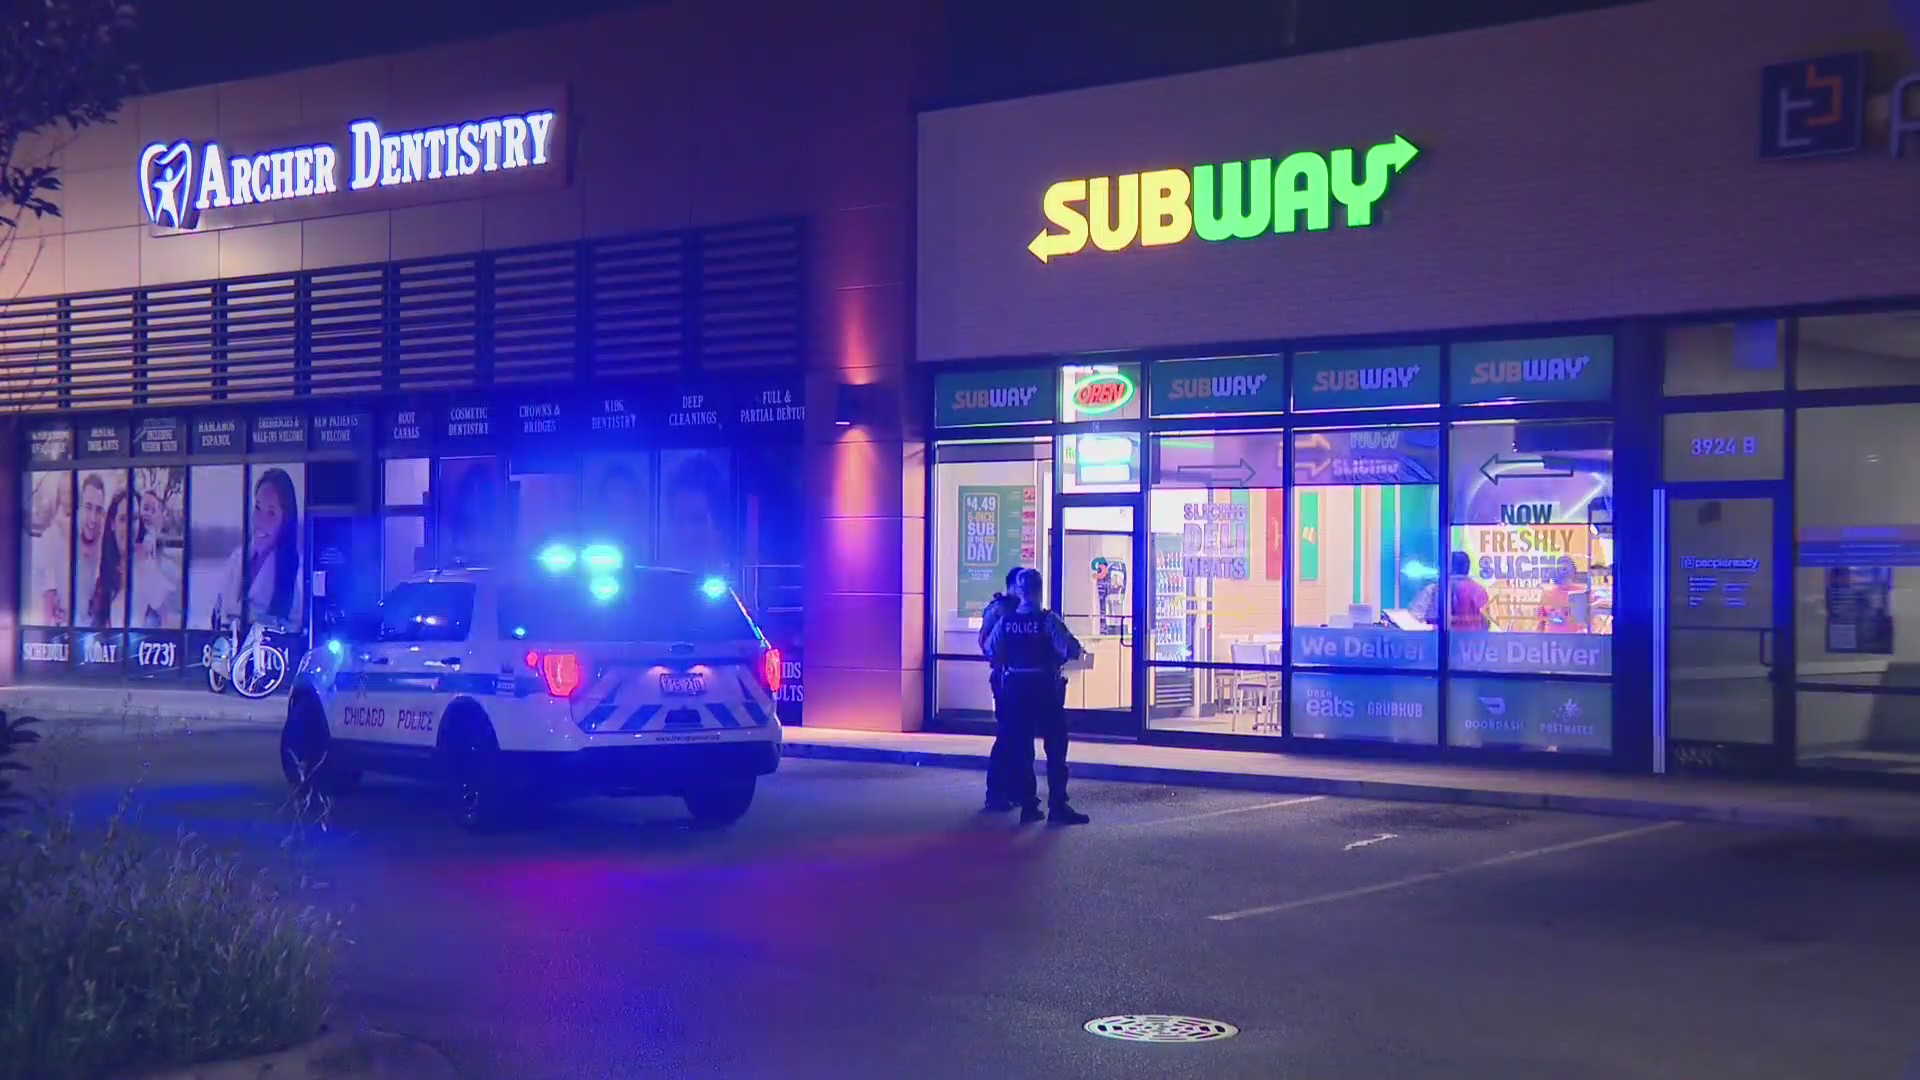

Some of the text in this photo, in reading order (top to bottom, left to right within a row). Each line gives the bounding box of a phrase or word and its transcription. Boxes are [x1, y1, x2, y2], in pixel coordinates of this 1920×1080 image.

[196, 110, 553, 210] ARCHER DENTISTRY
[1027, 133, 1419, 264] SUBWAY
[1313, 365, 1420, 393] SUBWAY
[1470, 356, 1591, 385] SUBWAY
[1077, 383, 1126, 405] OPEN
[1168, 373, 1268, 401] SUBWAY
[682, 395, 704, 409] DEEP
[762, 389, 792, 405] FULL &
[952, 385, 1038, 411] SUBWAY
[450, 407, 488, 421] COSMETIC
[519, 404, 561, 418] CROWNS &
[604, 399, 625, 413] KIDS
[329, 415, 358, 427] PATIENTS
[592, 414, 637, 431] DENTISTRY
[668, 411, 717, 427] CLEANINGS
[740, 408, 775, 423] PARTIAL
[394, 427, 420, 440] CANALS
[448, 423, 489, 437] DENTISTRY
[523, 420, 557, 433] BRIDGES
[321, 430, 350, 441] WELCOME
[1691, 438, 1736, 456] 3924
[966, 496, 996, 511] $4.49
[1183, 503, 1247, 521] SLICING
[1500, 503, 1552, 525] NOW
[967, 522, 995, 536] SUB
[1183, 523, 1246, 555] DELI
[1480, 529, 1574, 553] FRESHLY
[967, 543, 994, 561] DAY
[1183, 556, 1246, 579] MEATS
[1005, 621, 1039, 634] POLICE
[138, 642, 176, 666] (773)
[1302, 634, 1424, 661] We Deliver
[1460, 639, 1600, 667] We Deliver
[1306, 696, 1354, 717] eats
[1367, 700, 1423, 717] GRUBHUB
[344, 706, 433, 731] CHICAGO POLICE
[1465, 719, 1524, 731] DOORDASH
[1540, 723, 1593, 736] POSTMATES
